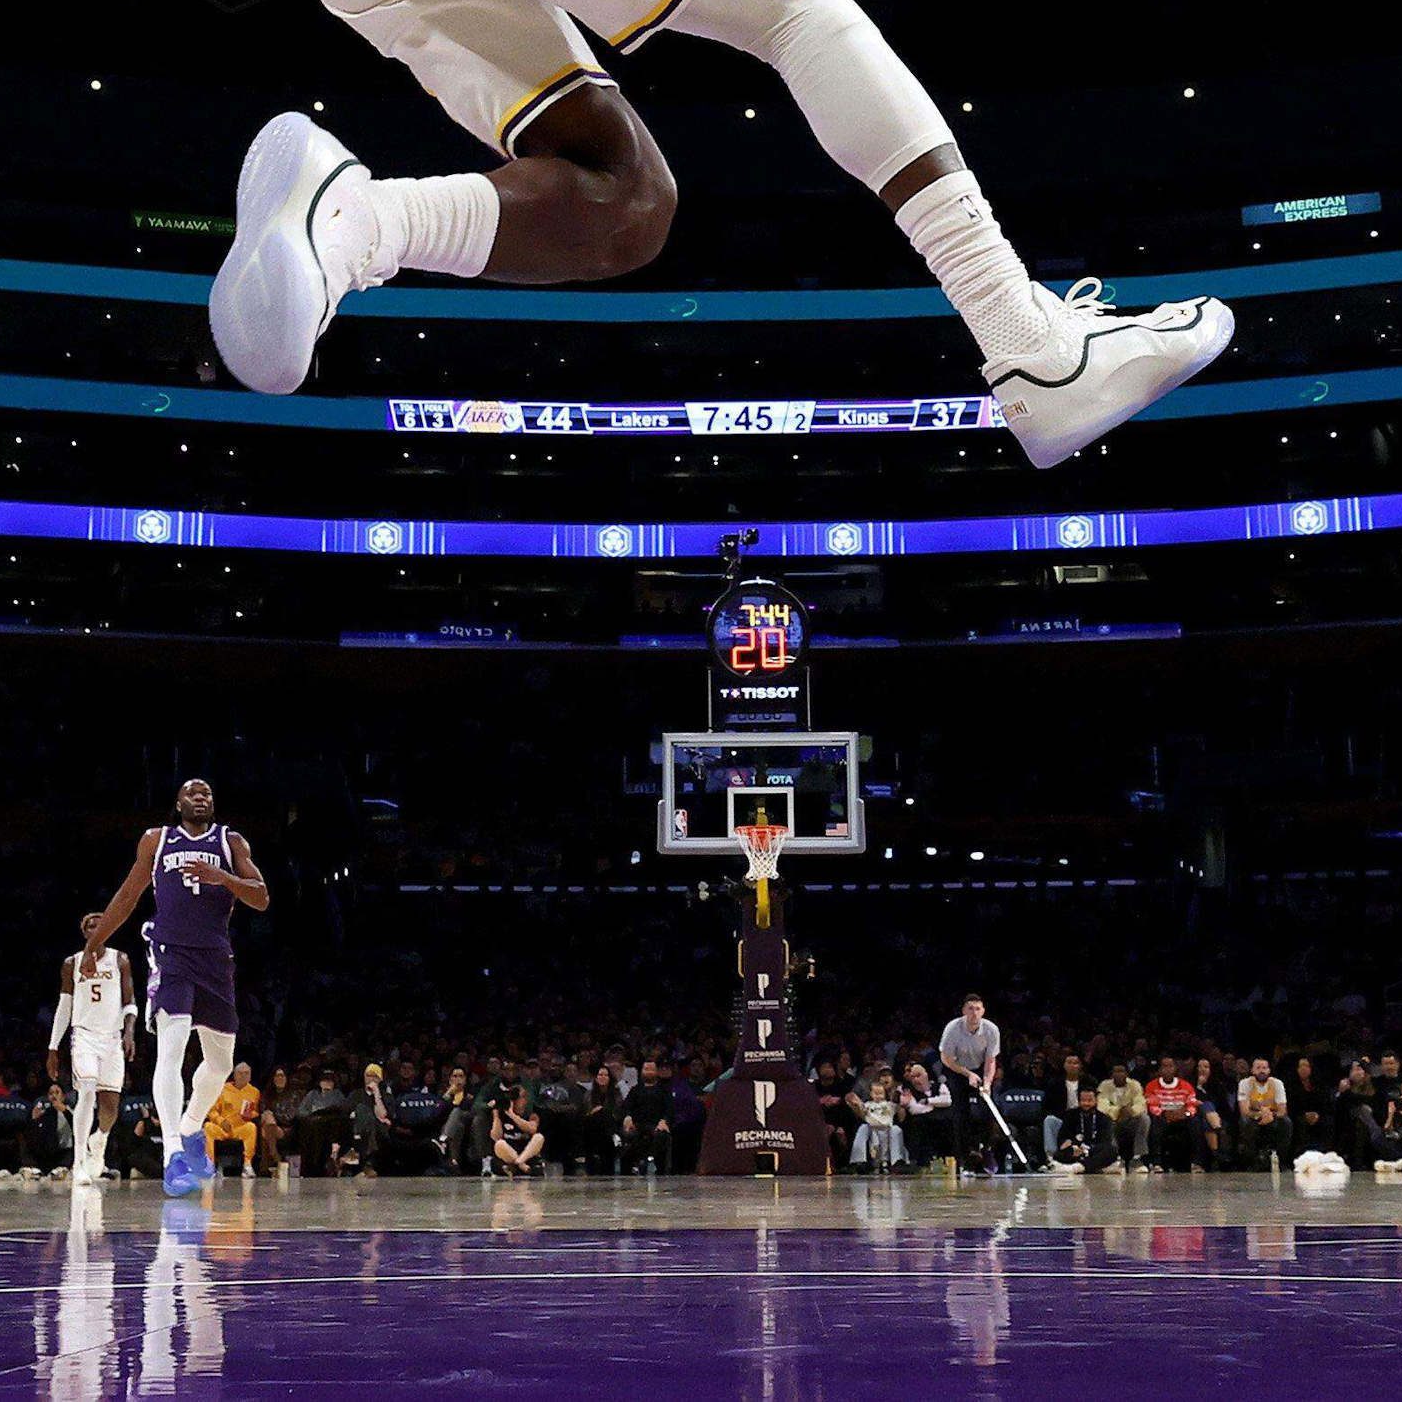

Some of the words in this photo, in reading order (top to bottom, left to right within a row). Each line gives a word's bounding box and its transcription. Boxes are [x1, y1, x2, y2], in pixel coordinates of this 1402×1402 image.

[1274, 194, 1346, 213] AMERICAN
[1284, 206, 1348, 222] EXPRESS
[404, 413, 416, 428] 6
[432, 413, 444, 428] 3
[459, 407, 515, 425] LAKERS
[537, 406, 572, 430] 44
[610, 410, 669, 427] Lakers
[703, 406, 773, 432] 7:45
[794, 413, 806, 432] 2
[838, 408, 889, 428] Kings
[931, 402, 966, 426] 37
[740, 604, 790, 627] 7:44
[731, 627, 786, 669] 20
[741, 687, 799, 699] TISSOT
[91, 984, 102, 1003] 5
[735, 1131, 794, 1143] PECHANGA
